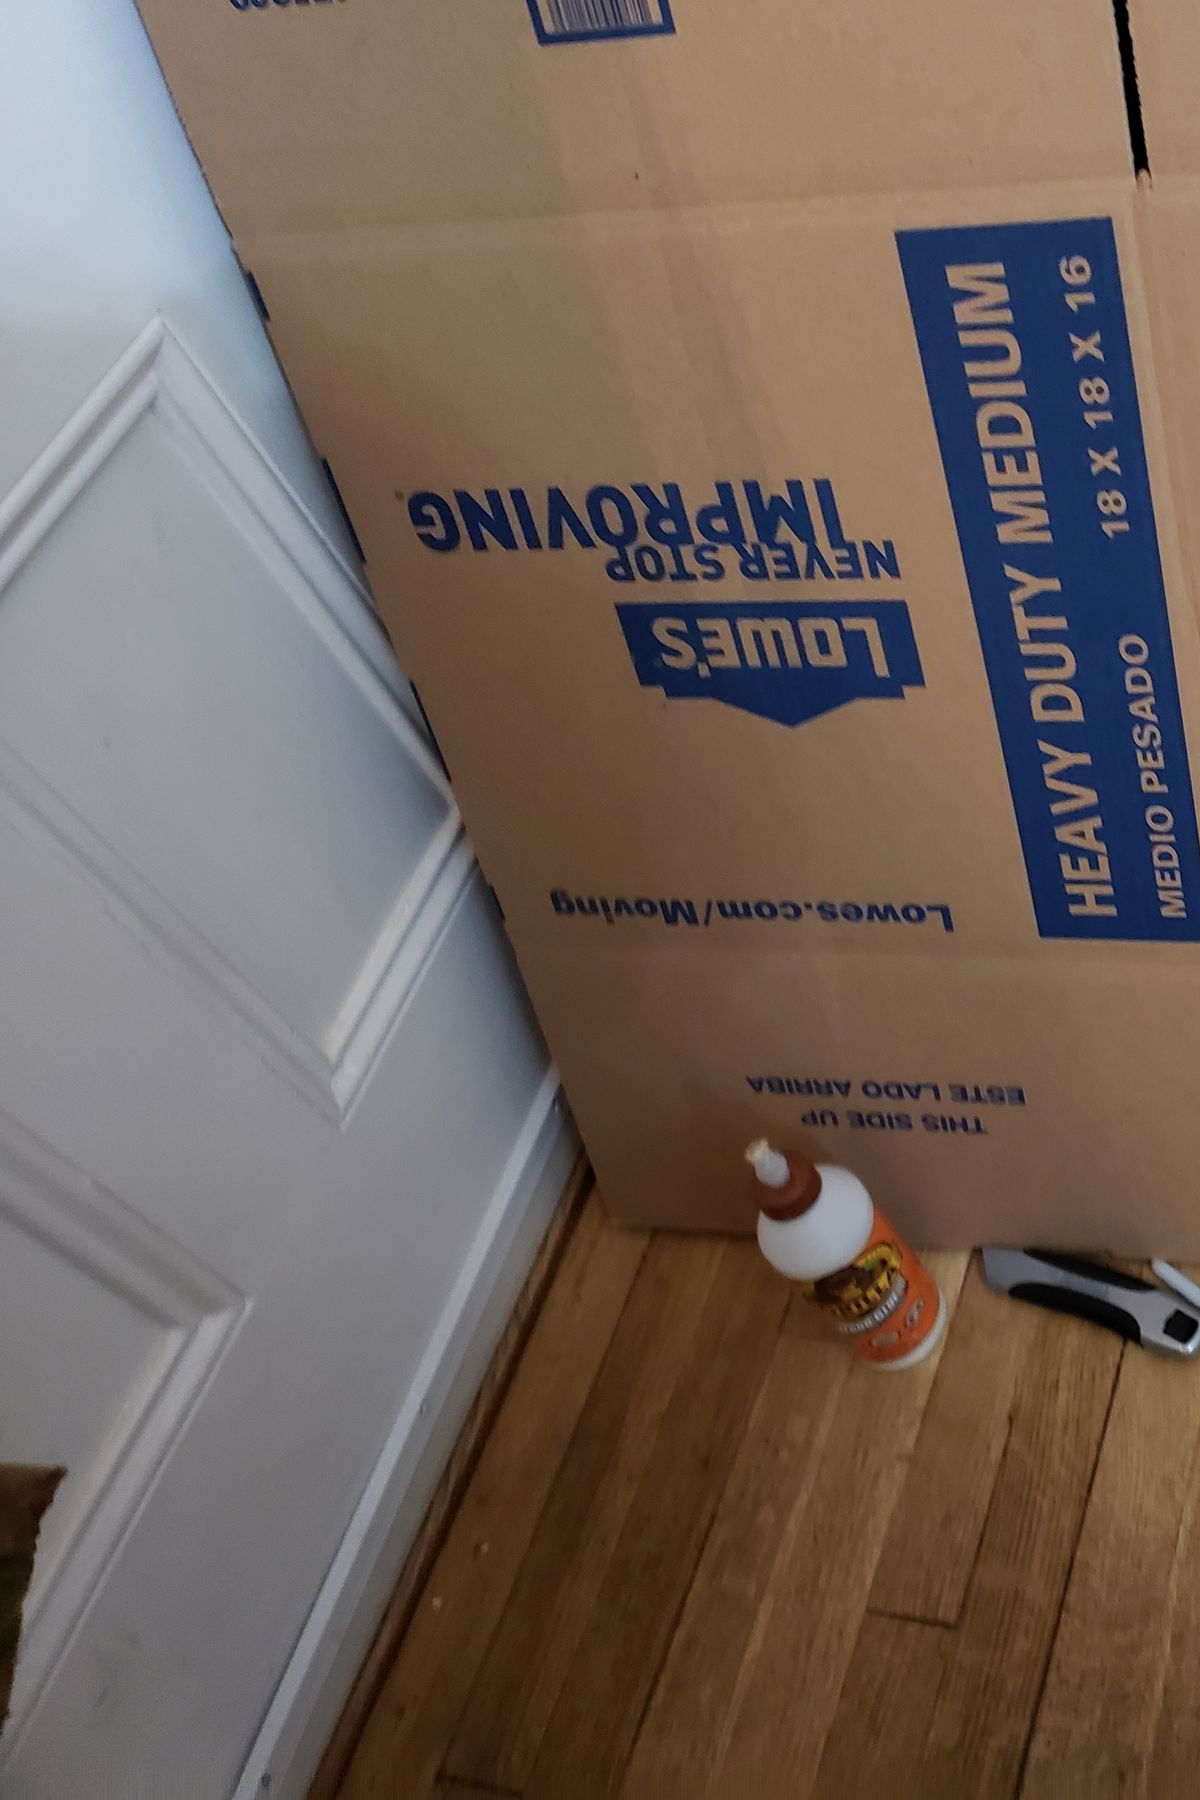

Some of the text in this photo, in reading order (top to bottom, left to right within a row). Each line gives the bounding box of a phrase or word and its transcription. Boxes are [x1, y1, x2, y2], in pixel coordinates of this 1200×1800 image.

[1060, 255, 1130, 540] 18 X 18 X 16
[408, 479, 846, 552] IMPROVING
[605, 540, 900, 583] NEVER STOP
[945, 263, 1116, 916] HEAVY DUTY MEDIUM
[652, 617, 889, 678] LOWE'S
[1119, 634, 1188, 921] MEDIO PESADO
[550, 889, 955, 933] Lowes.com/Moving
[746, 1075, 1026, 1106] ESTE LADO ARRIBA
[801, 1108, 986, 1135] THIS SIDE UP
